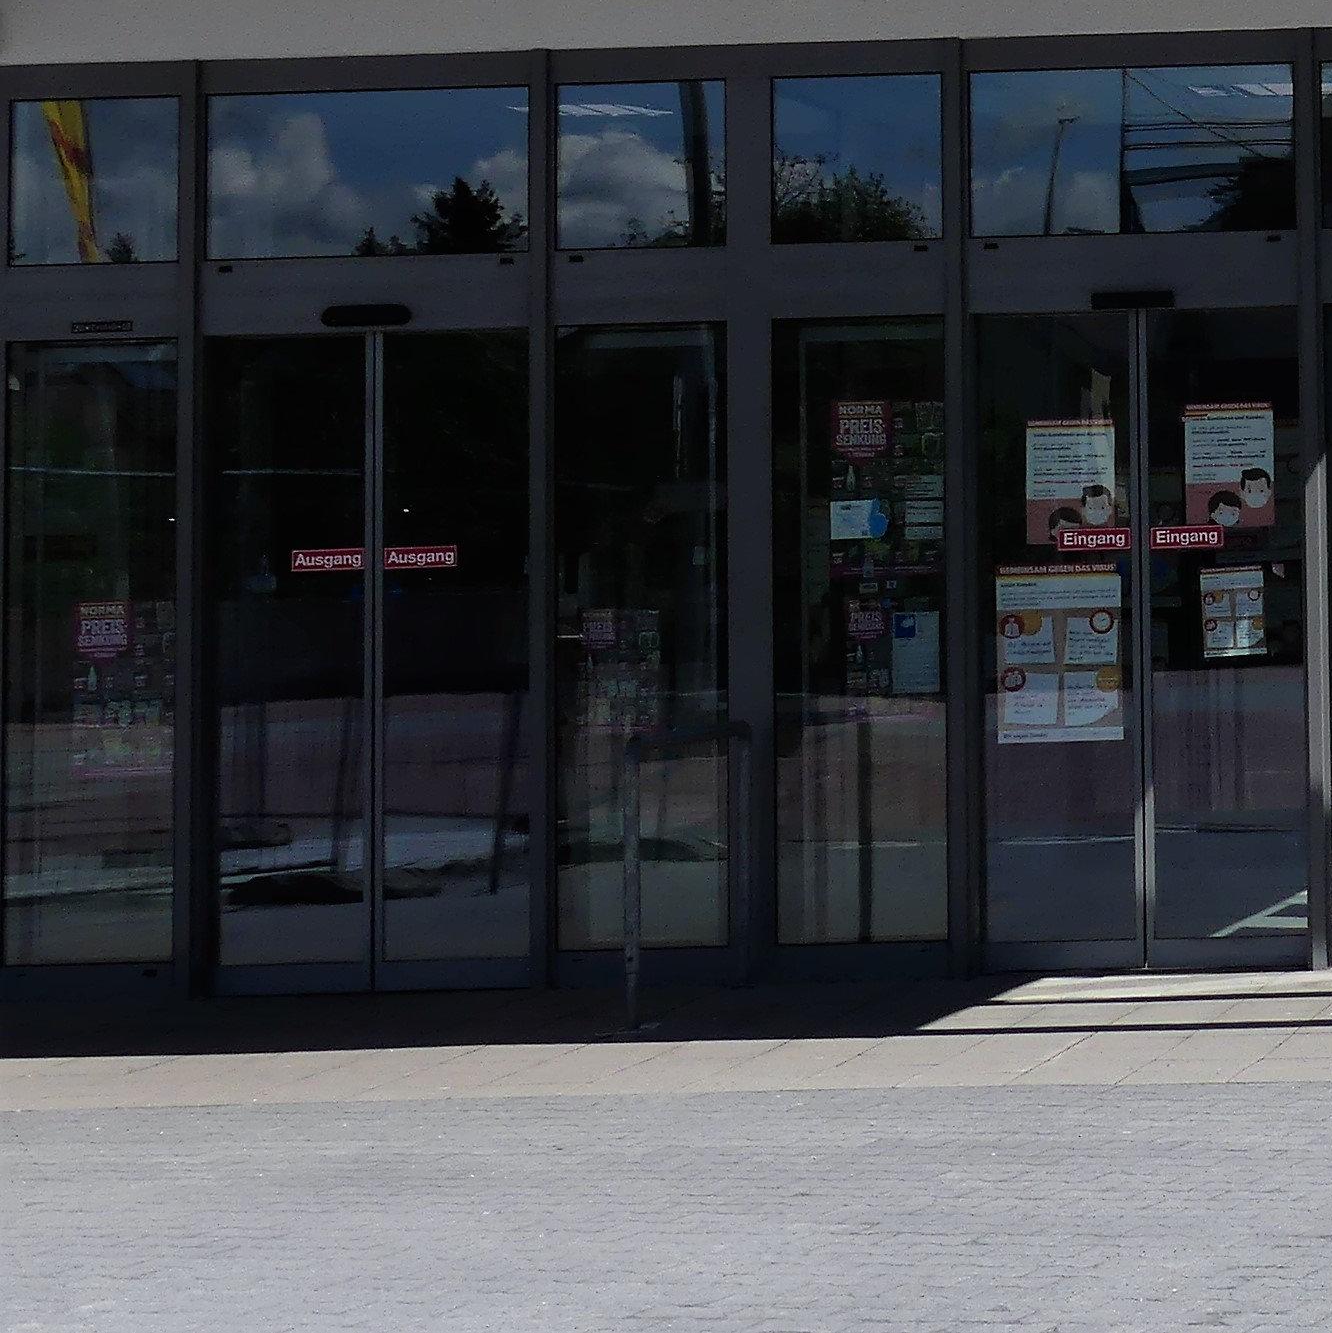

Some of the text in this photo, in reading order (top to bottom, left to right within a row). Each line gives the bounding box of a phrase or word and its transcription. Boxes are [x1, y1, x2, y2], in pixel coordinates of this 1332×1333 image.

[839, 418, 885, 434] PREIS
[1062, 531, 1126, 548] Eingang
[1155, 530, 1219, 546] Eingang
[294, 552, 362, 568] Ausgang
[387, 550, 455, 566] Ausgang
